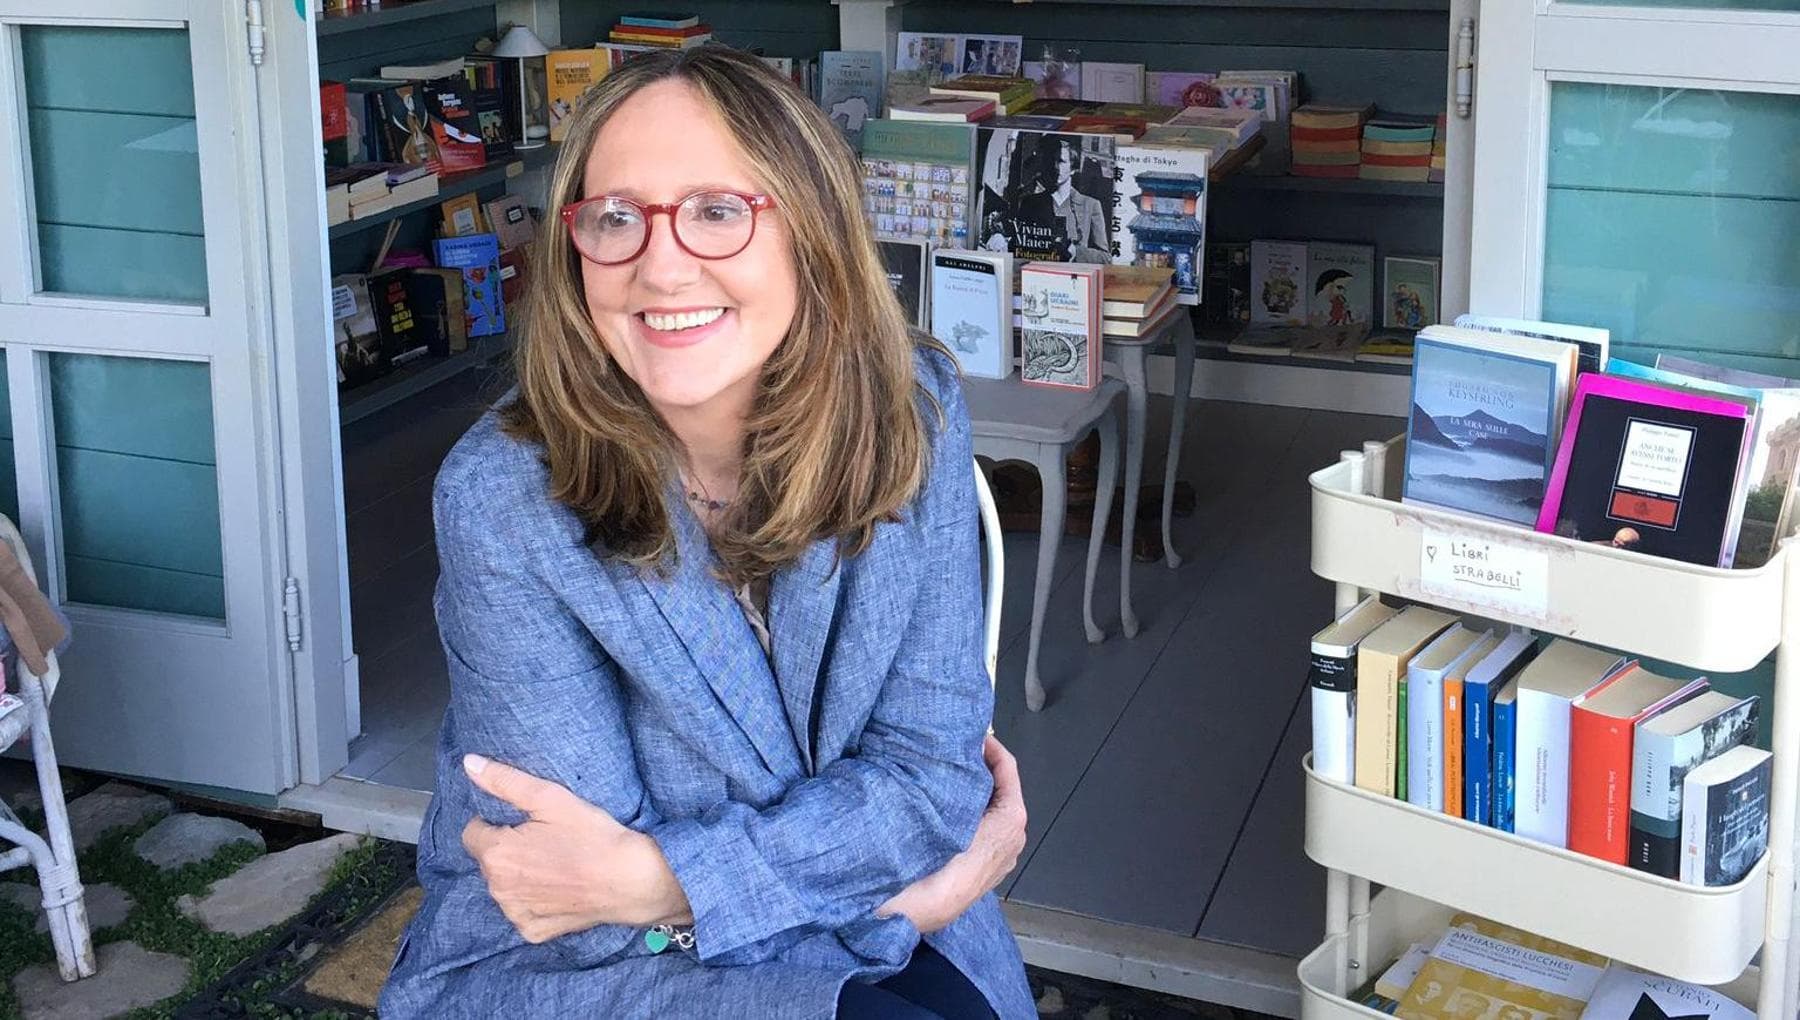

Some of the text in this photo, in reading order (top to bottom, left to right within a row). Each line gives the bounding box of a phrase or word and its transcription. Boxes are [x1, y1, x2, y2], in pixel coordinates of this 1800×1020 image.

[1143, 156, 1151, 164] di
[1153, 156, 1178, 167] Tokyo
[1011, 219, 1052, 237] Vivian
[1015, 234, 1052, 249] Maier
[1448, 389, 1514, 409] KEYSERLING
[1468, 430, 1489, 440] CASE
[1452, 932, 1521, 957] ANTIFASCISTI
[1523, 951, 1575, 972] LUCCHESI
[1643, 980, 1720, 1011] SCURATI
